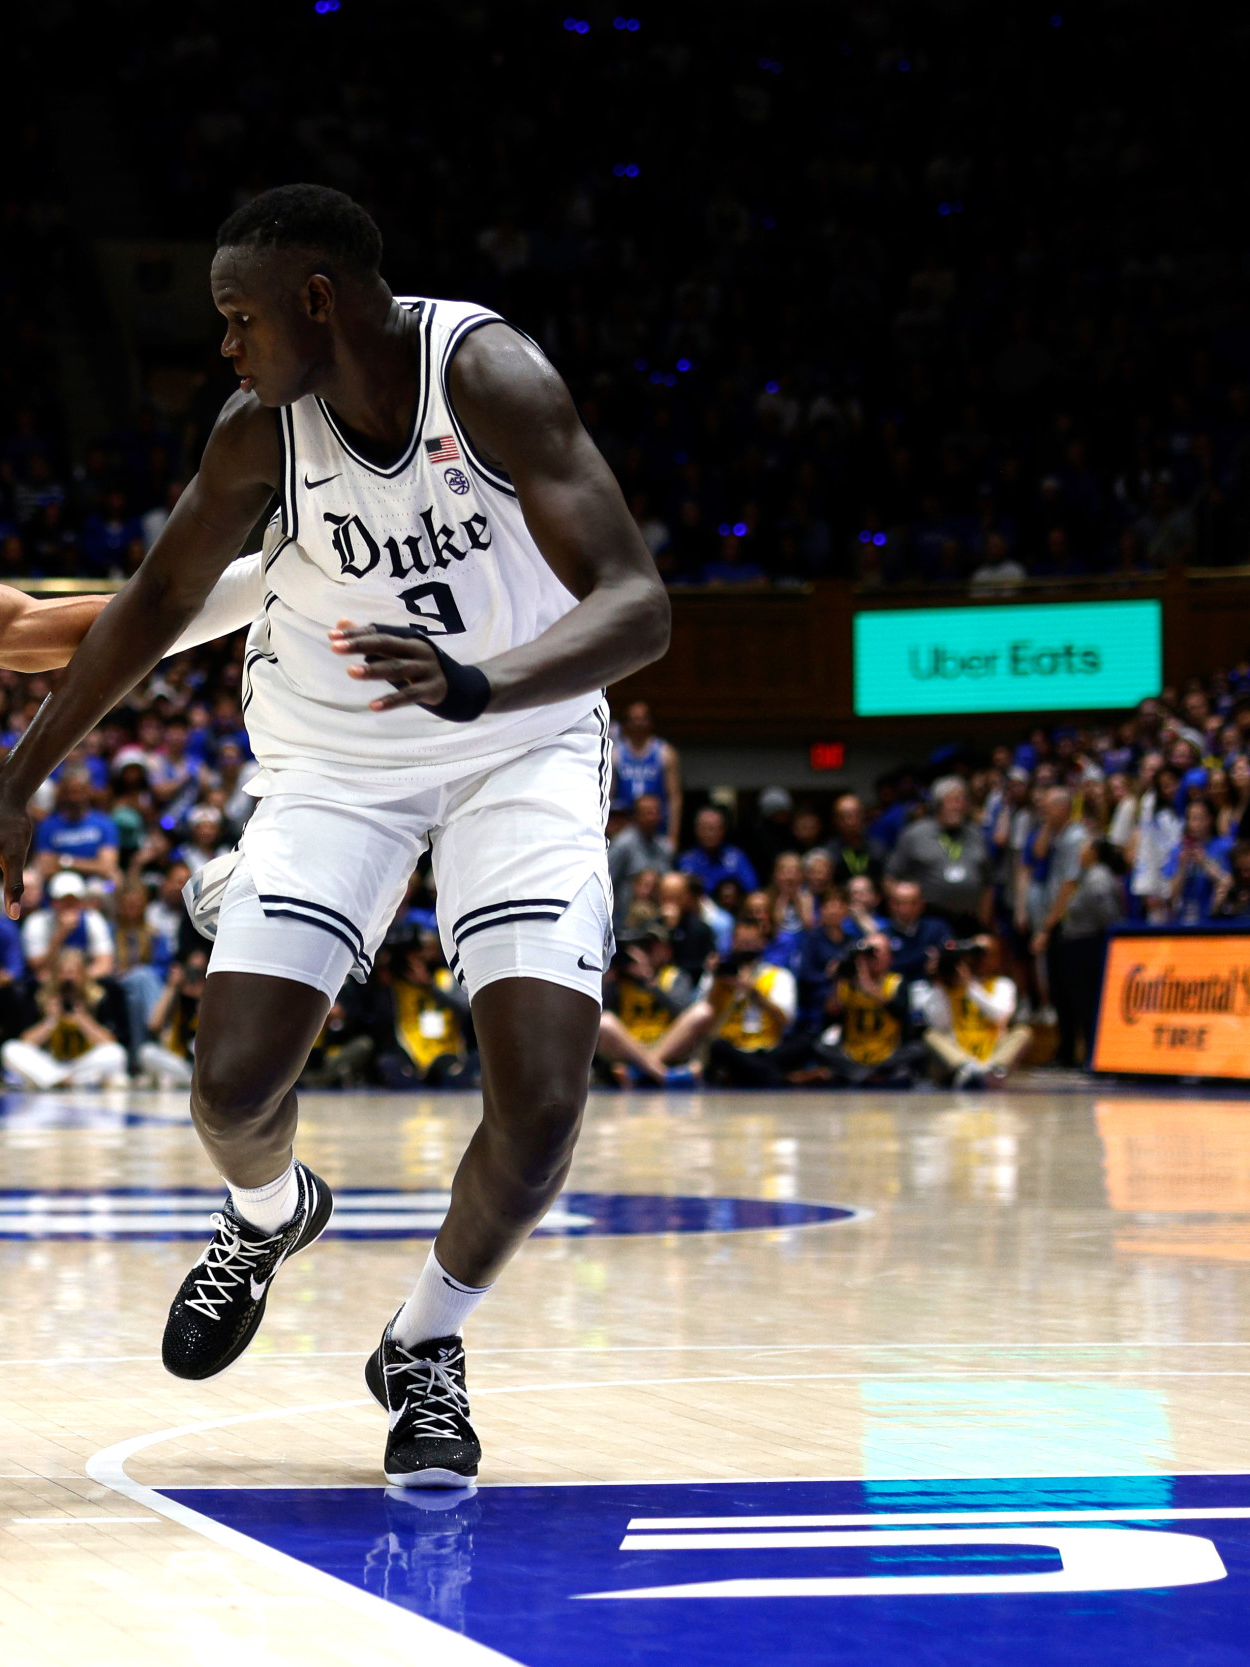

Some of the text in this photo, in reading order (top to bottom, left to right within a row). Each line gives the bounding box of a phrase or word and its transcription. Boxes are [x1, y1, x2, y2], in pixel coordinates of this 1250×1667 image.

[323, 505, 492, 579] Duke
[908, 640, 1101, 681] Uber Eats
[1121, 963, 1239, 1026] Continental
[1153, 1024, 1208, 1052] TIRE
